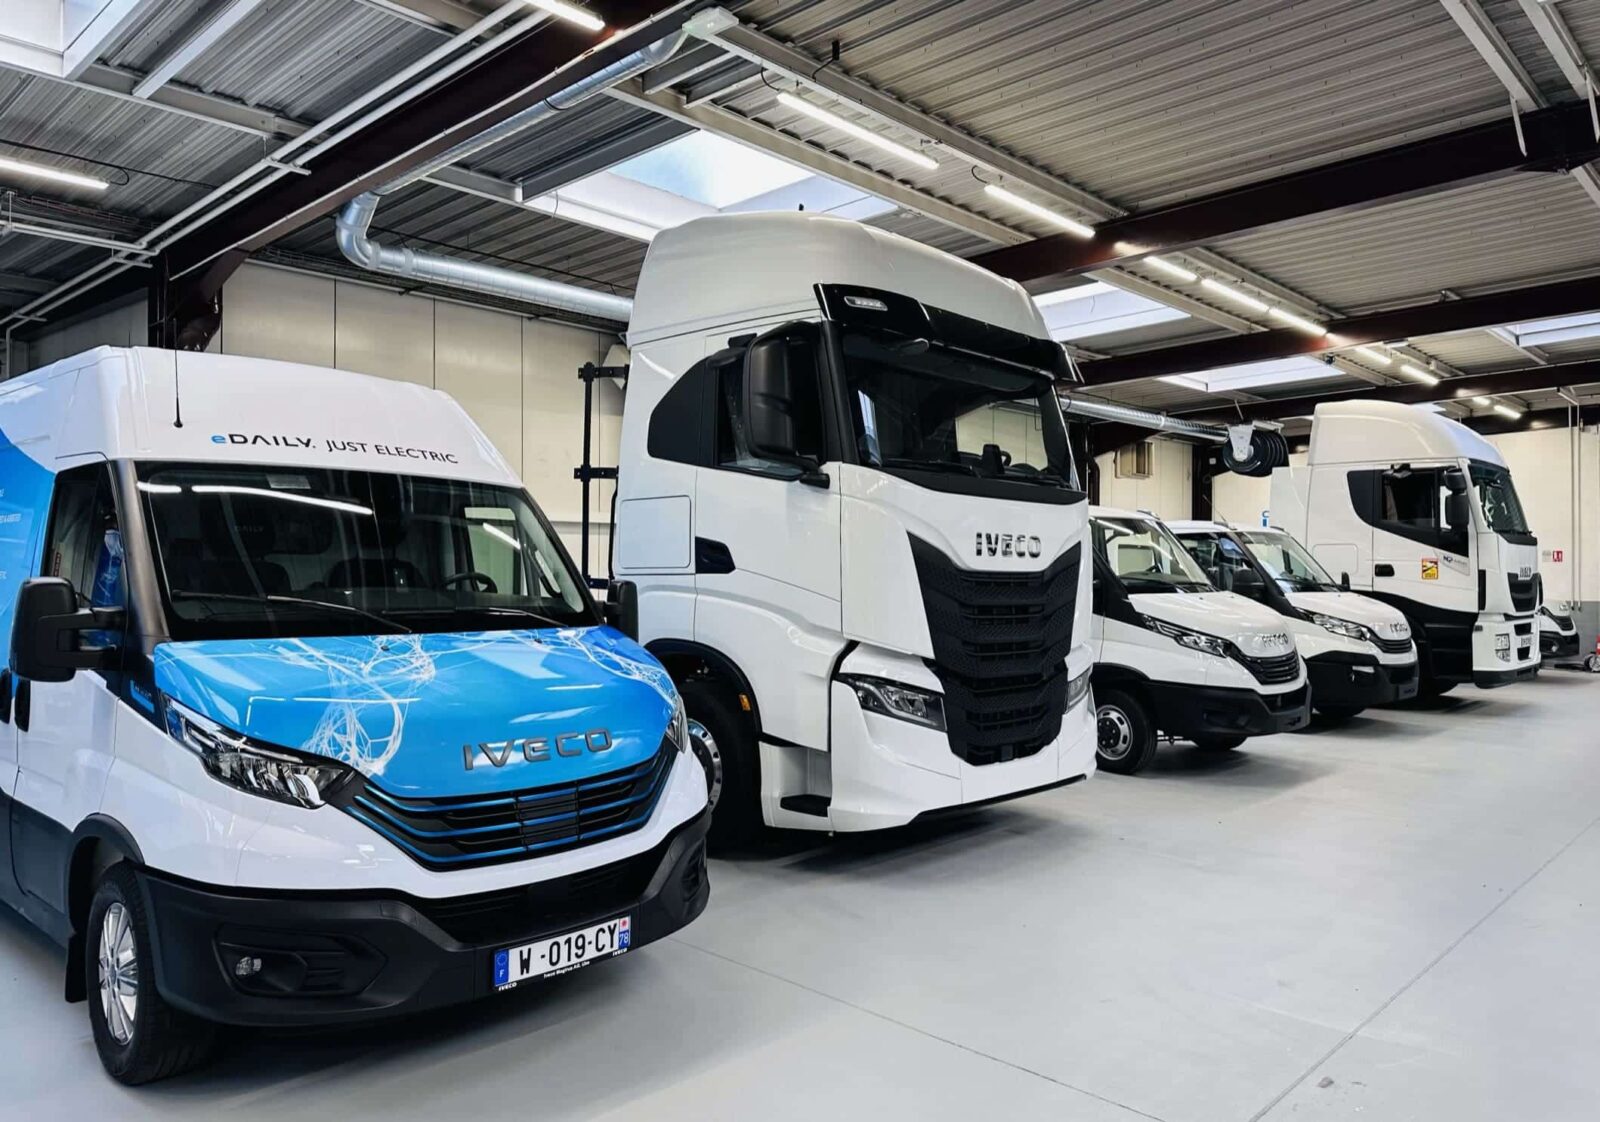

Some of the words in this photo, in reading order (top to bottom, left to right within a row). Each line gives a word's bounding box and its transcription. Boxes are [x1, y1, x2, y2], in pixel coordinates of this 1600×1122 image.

[326, 439, 368, 452] JUST
[375, 444, 459, 464] ELECTRIC
[976, 532, 1042, 558] IVECO
[463, 728, 613, 771] IVECO
[619, 932, 629, 946] 78
[499, 969, 505, 978] F
[498, 981, 518, 992] IVECO
